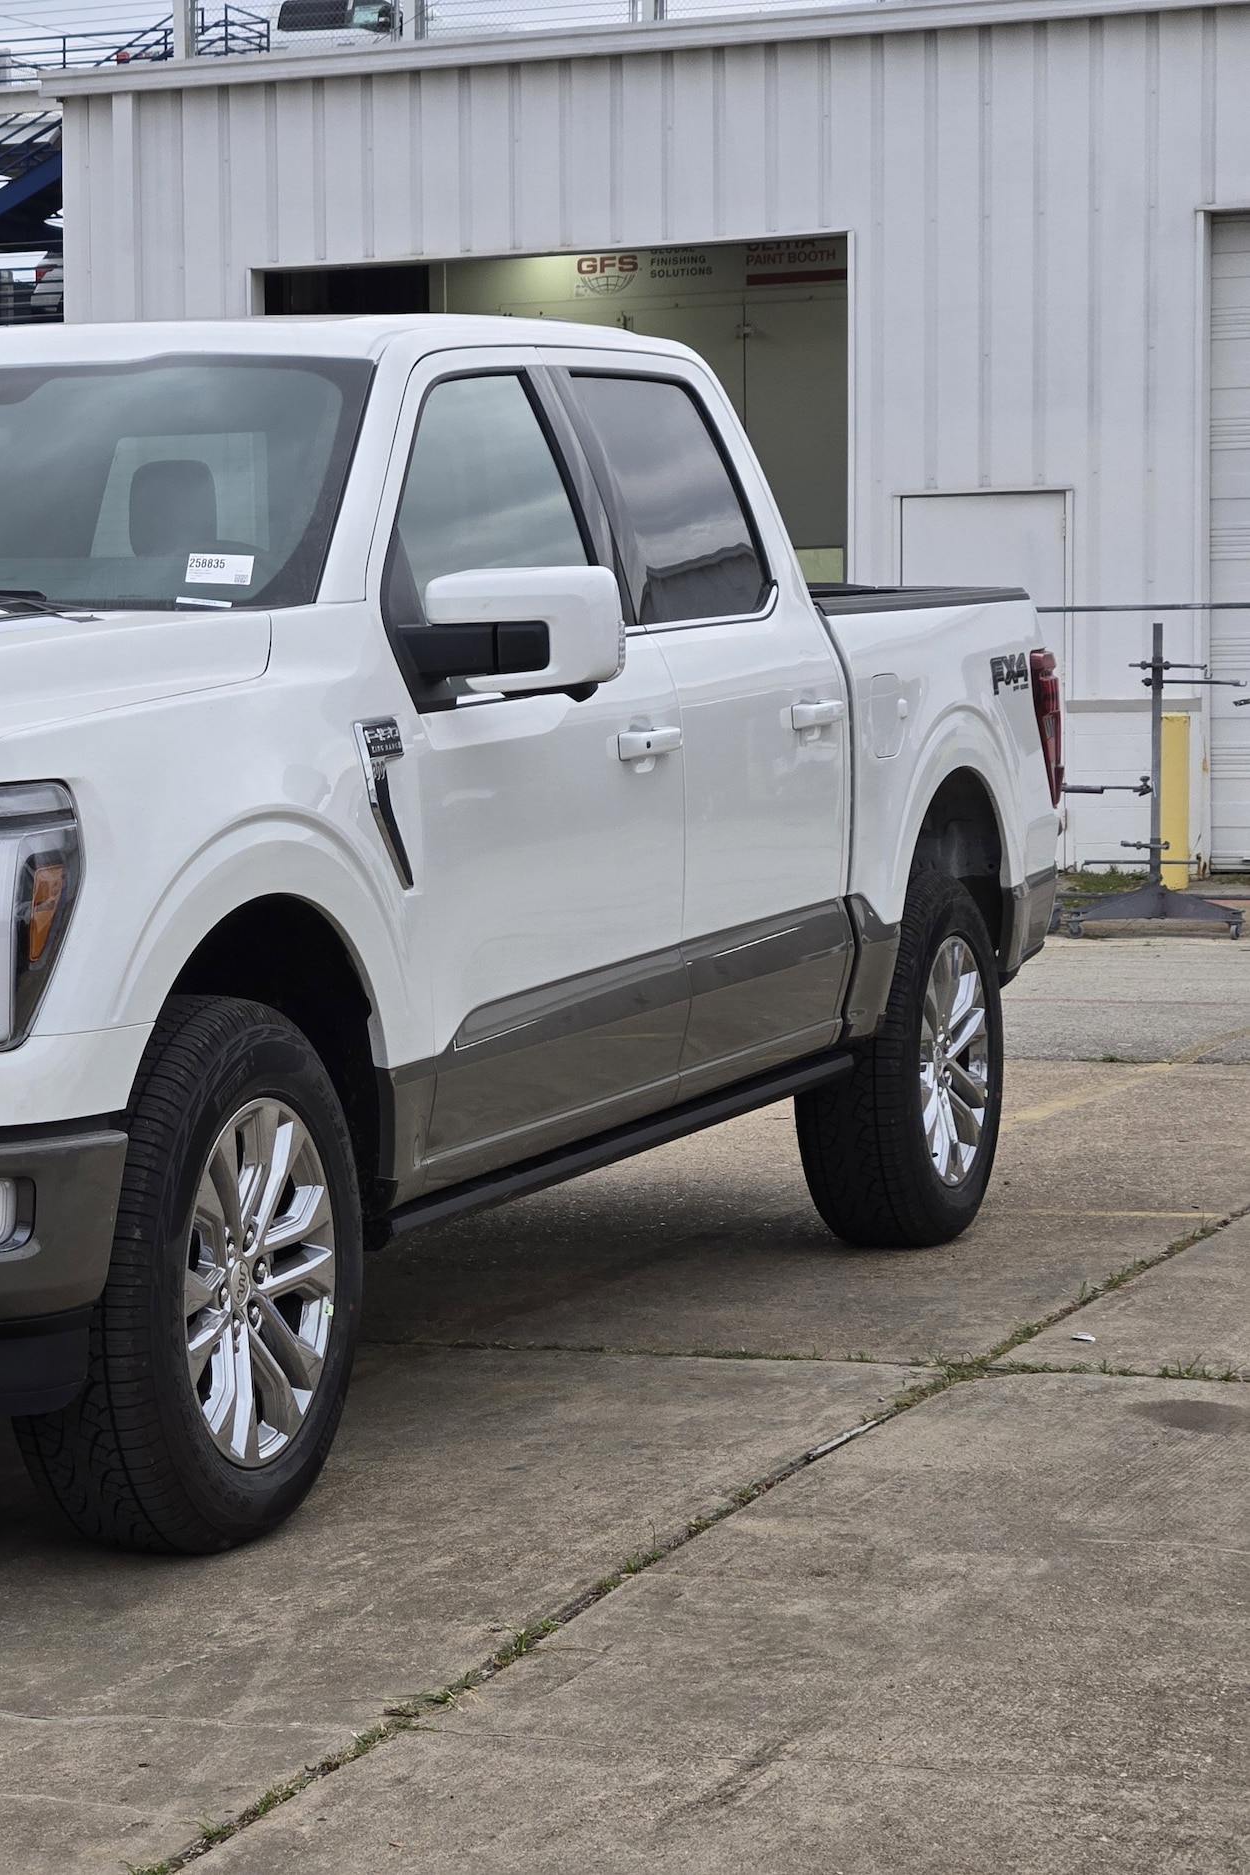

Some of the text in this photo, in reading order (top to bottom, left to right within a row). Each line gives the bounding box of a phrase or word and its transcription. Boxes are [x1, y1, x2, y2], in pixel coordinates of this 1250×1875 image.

[577, 254, 639, 275] GFS
[650, 255, 706, 266] FINISHING
[746, 248, 836, 266] PAINT BOOTH
[650, 266, 713, 278] SOLUTIONS
[189, 558, 226, 569] 258835
[990, 652, 1029, 695] FX4
